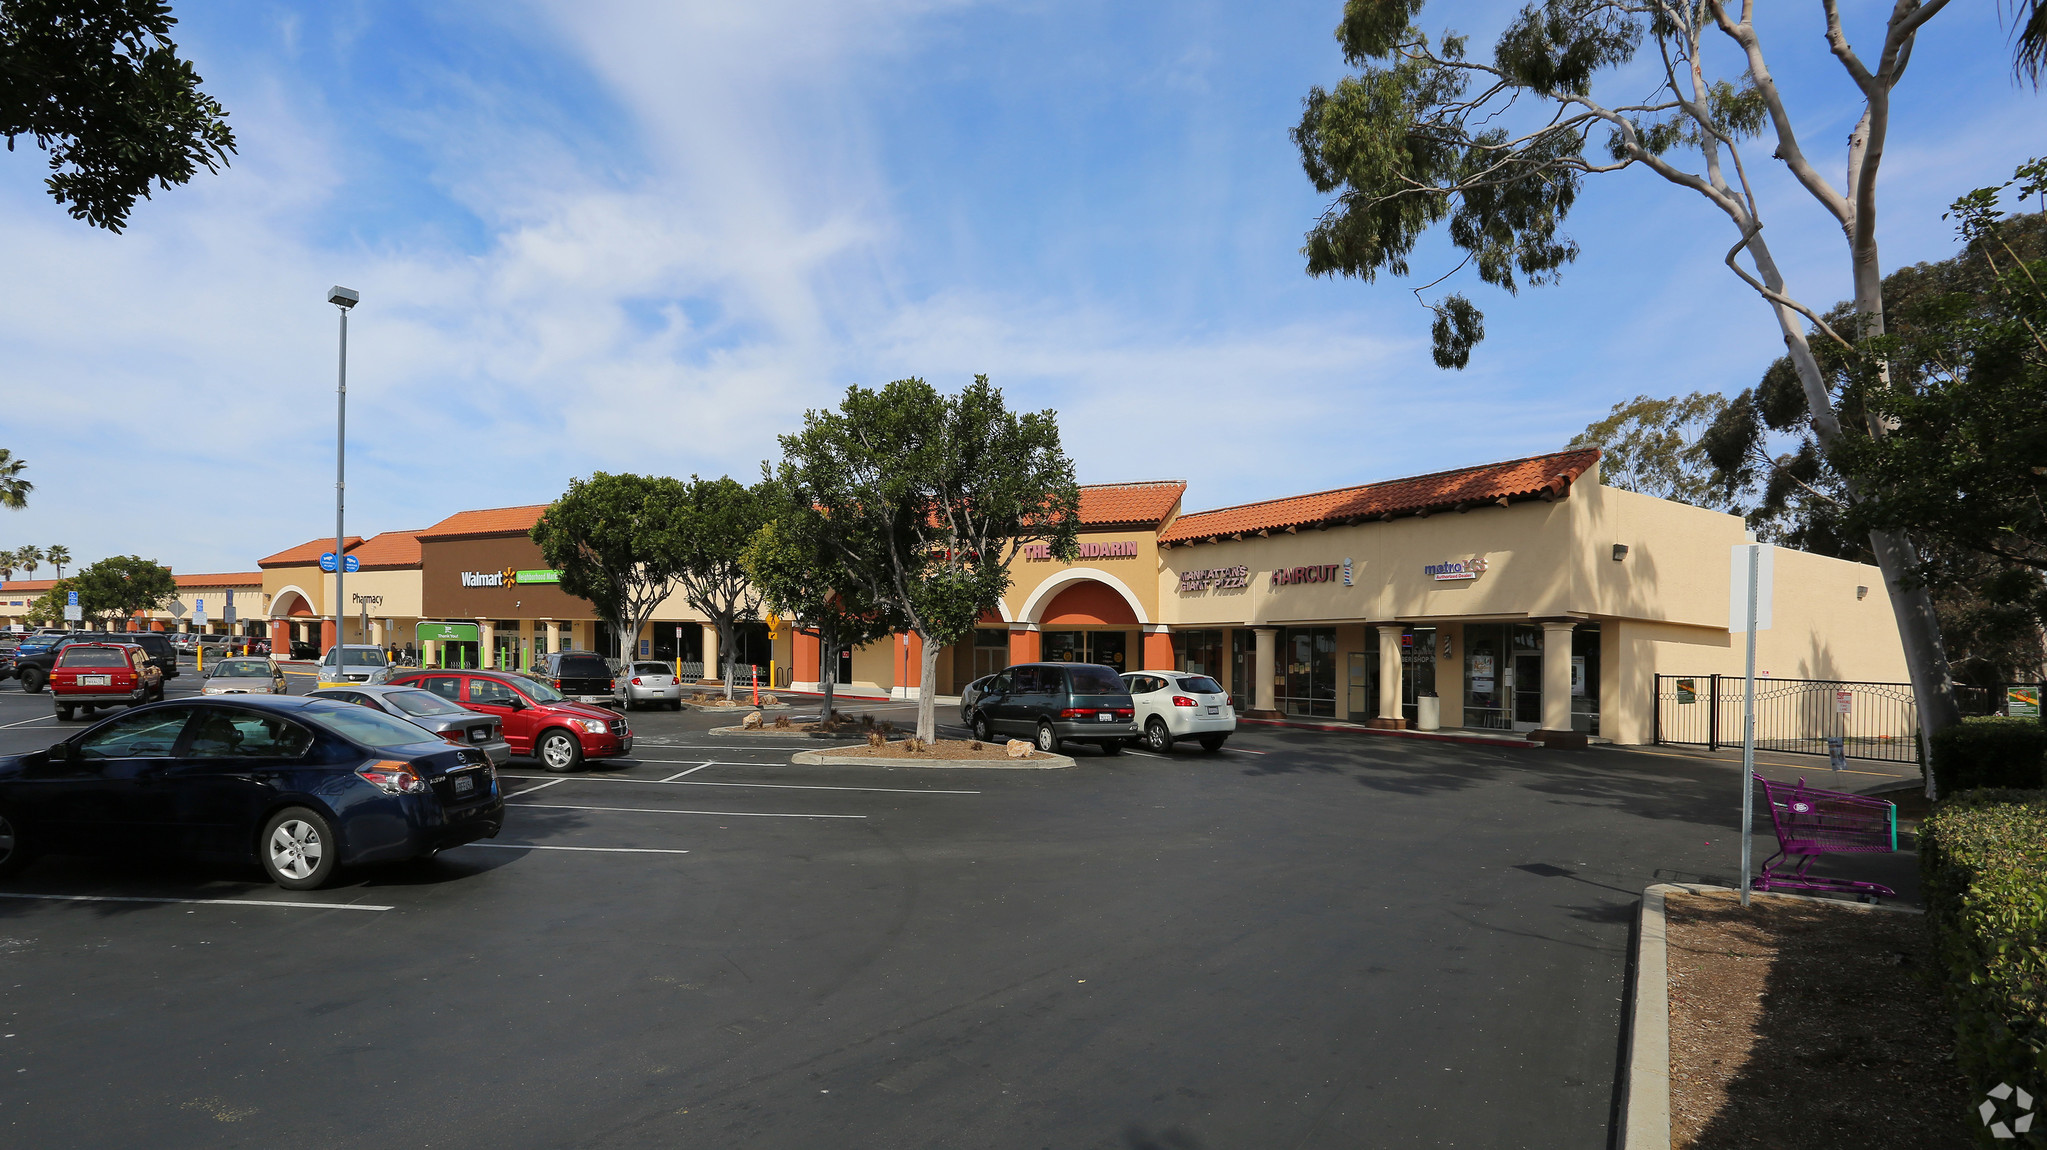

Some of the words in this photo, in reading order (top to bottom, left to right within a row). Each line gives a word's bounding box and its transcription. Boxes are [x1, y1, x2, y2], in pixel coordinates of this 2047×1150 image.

[1024, 544, 1051, 559] THE
[1054, 541, 1138, 558] NDARIN
[461, 570, 503, 587] Walmart
[1271, 564, 1339, 586] HAIRCUT
[1181, 580, 1210, 592] GIANT
[1214, 577, 1247, 590] PIZZA
[352, 593, 384, 606] Pharmacy
